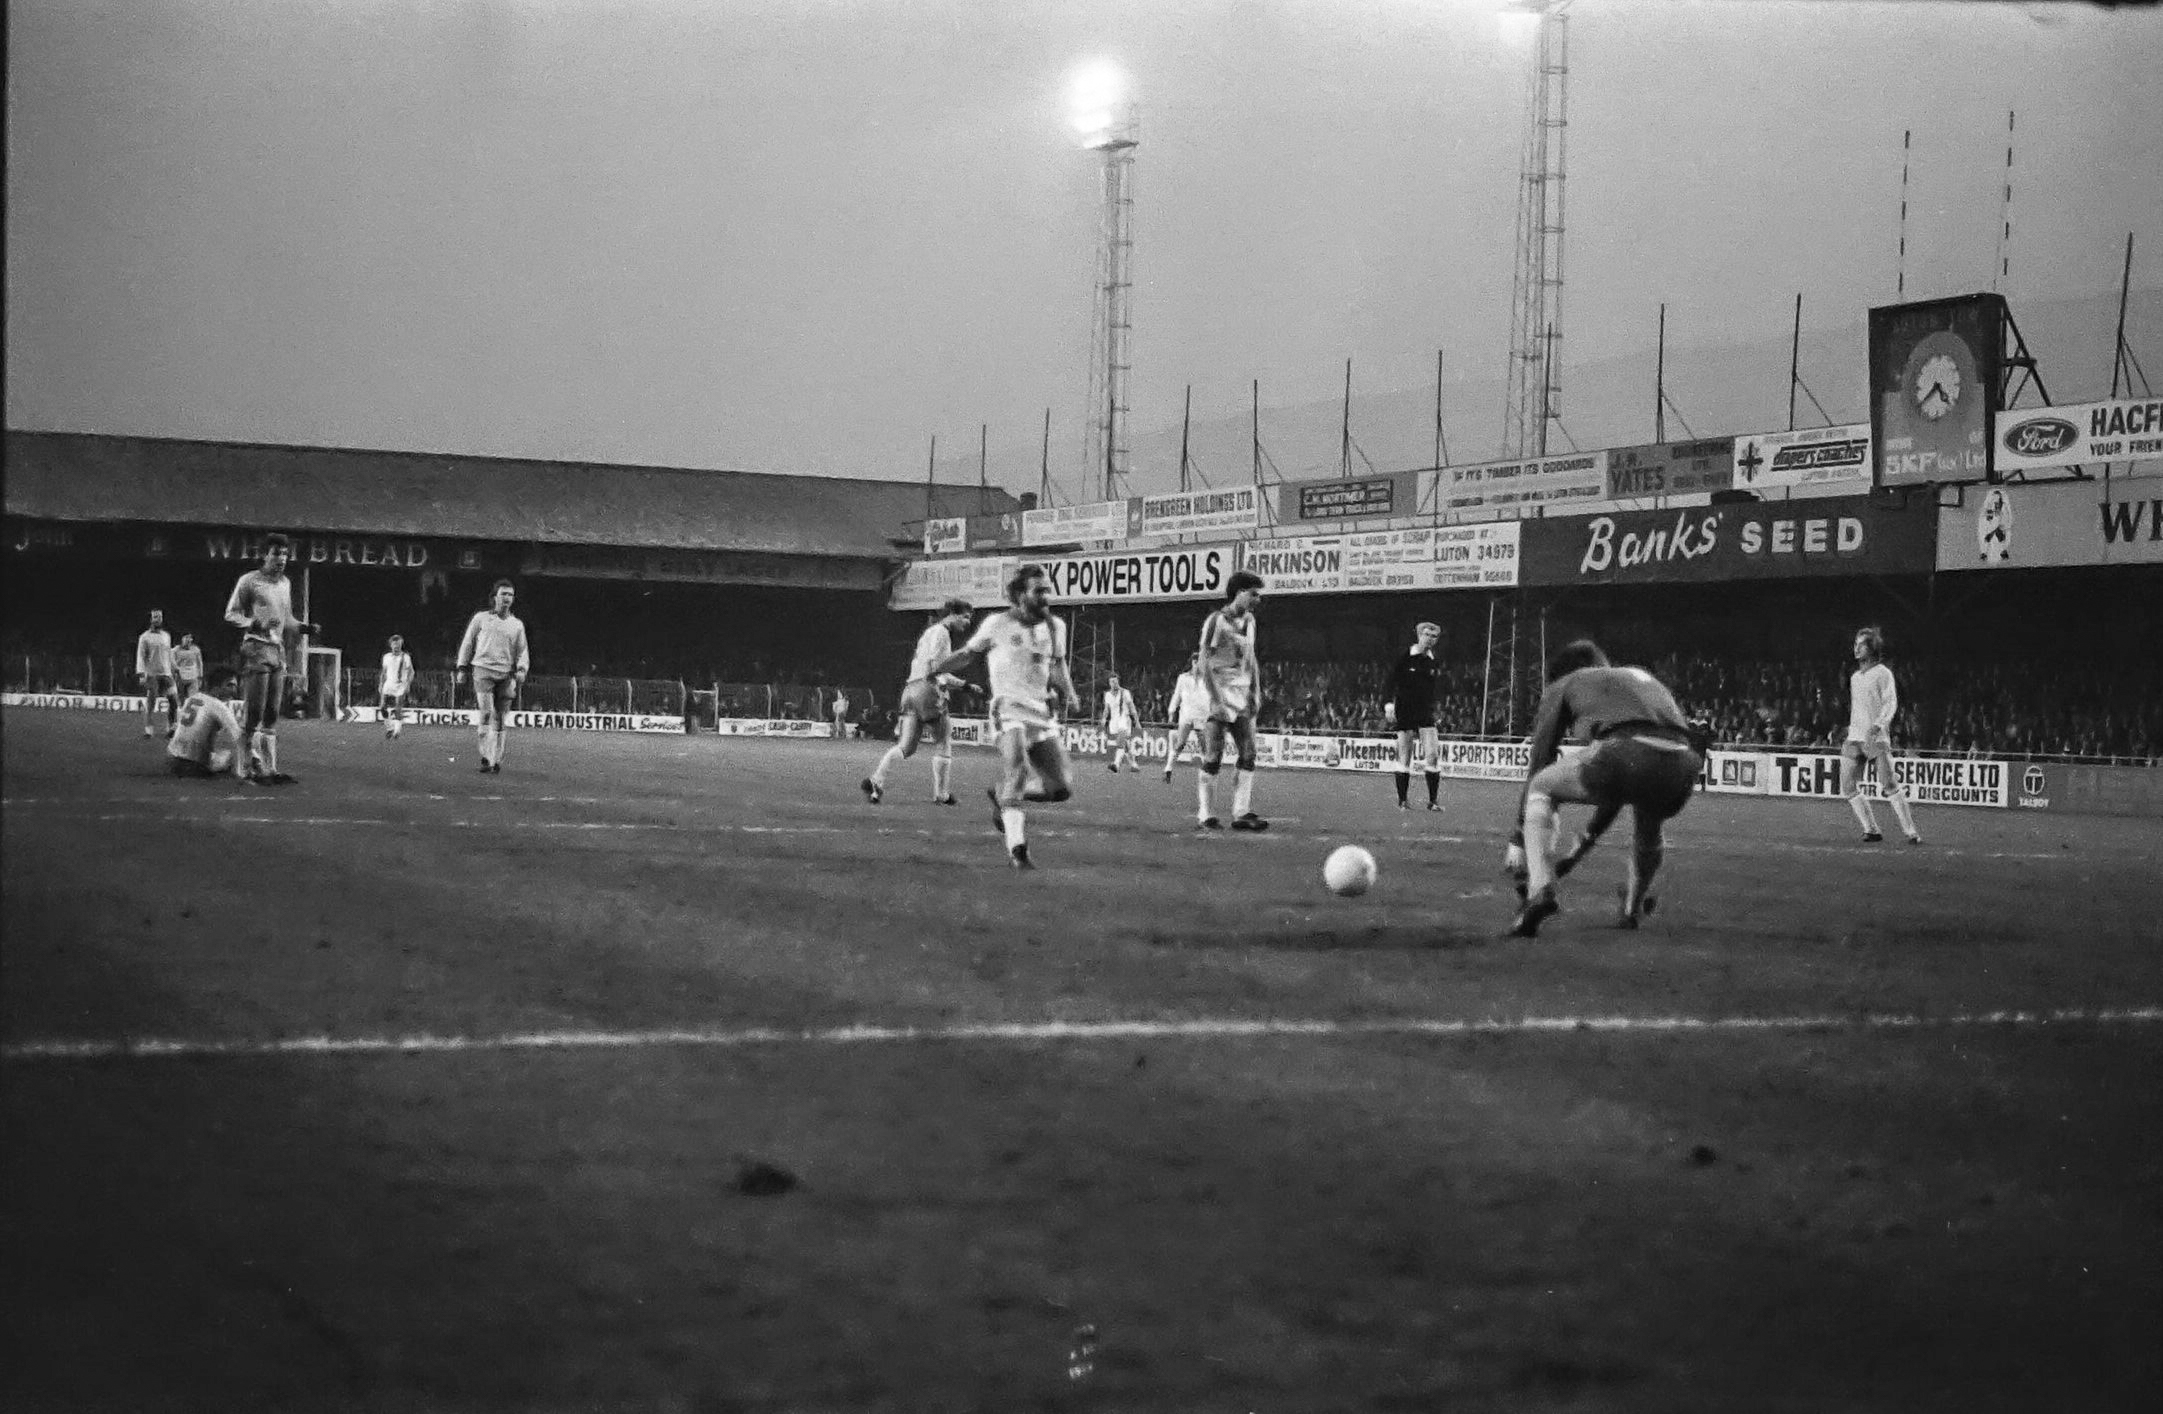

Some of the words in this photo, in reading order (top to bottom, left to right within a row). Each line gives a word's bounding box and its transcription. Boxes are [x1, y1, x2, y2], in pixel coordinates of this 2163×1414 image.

[2017, 425, 2065, 451] Ford
[2090, 441, 2121, 456] YOUR
[1611, 466, 1664, 493] YATES
[1740, 517, 1863, 553] SEED
[203, 535, 428, 567] WHTBREAD
[1246, 550, 1340, 575] ARKINSON
[1434, 545, 1469, 561] LUTON
[1066, 557, 1142, 595] POWER
[1145, 551, 1221, 593] TOOLS
[413, 709, 470, 725] Trucks
[514, 714, 634, 731] CLEANDUSTRIAL
[1065, 727, 1168, 758] Post-cho
[1452, 744, 1494, 764] SPORTS
[1497, 747, 1529, 767] PRES
[1774, 757, 1840, 795] T&H
[1894, 761, 1962, 788] SERVICE
[1968, 764, 1997, 787] LTD
[1917, 786, 1998, 803] DISCOUNTS
